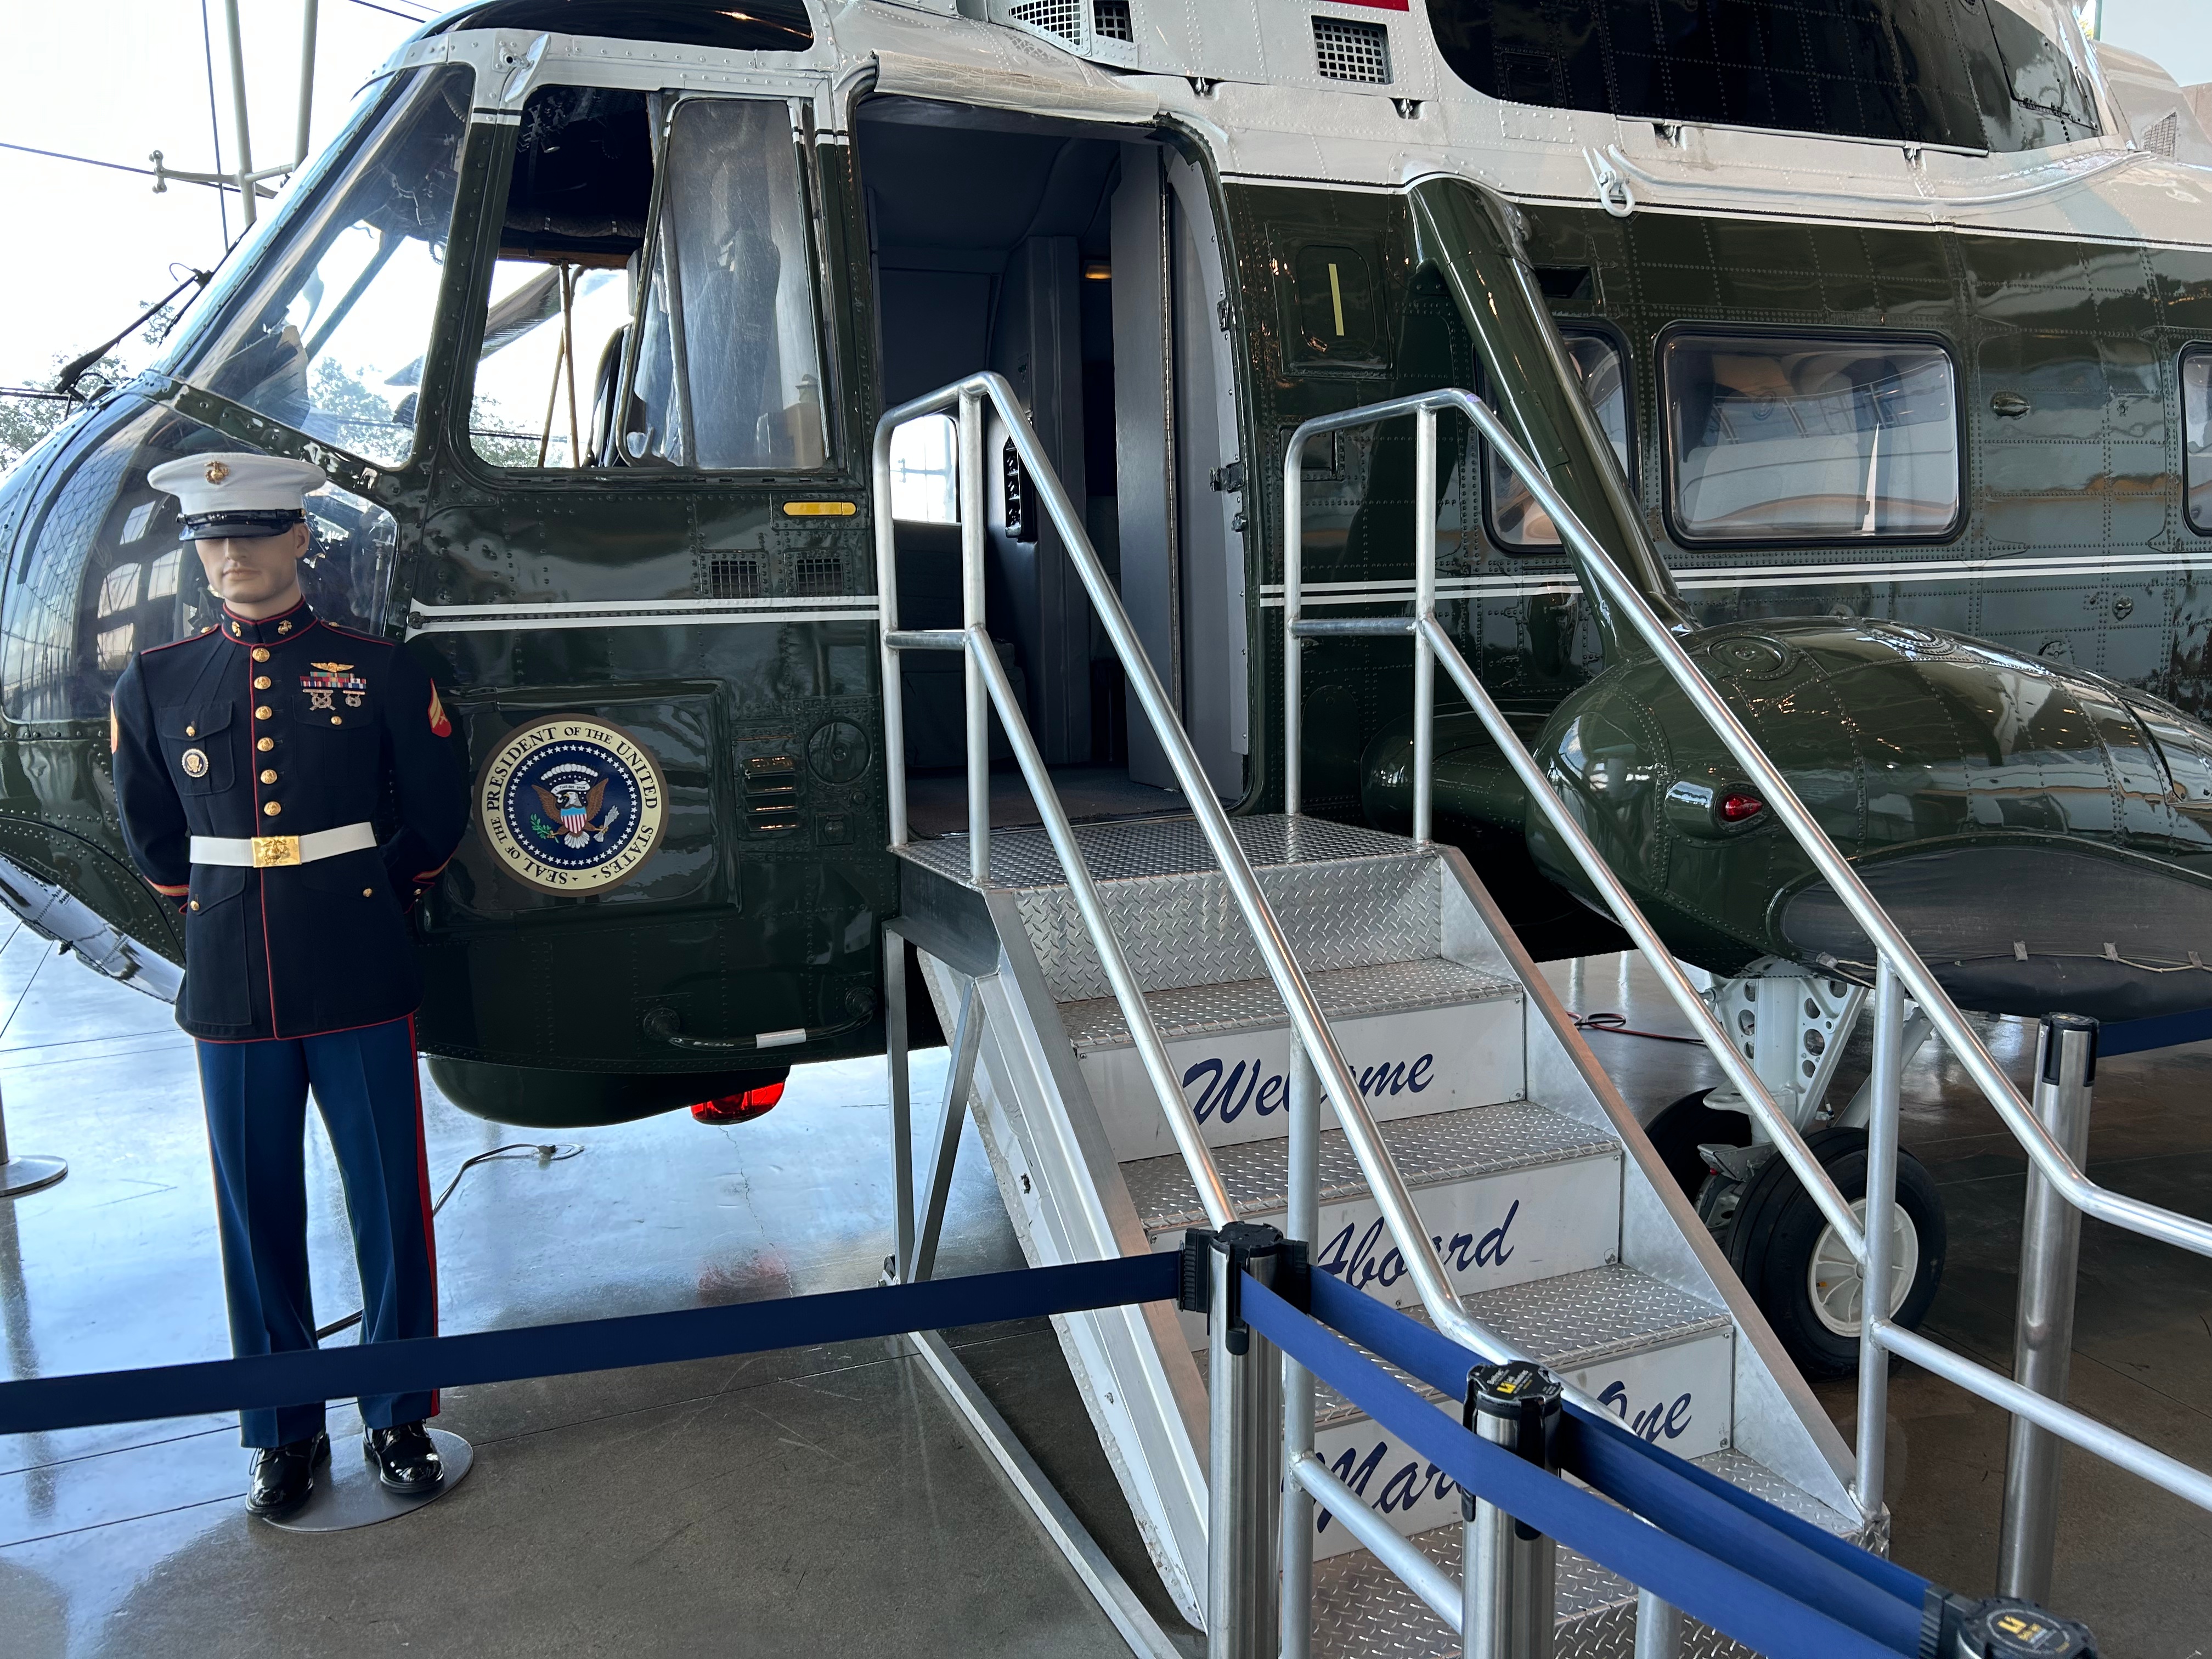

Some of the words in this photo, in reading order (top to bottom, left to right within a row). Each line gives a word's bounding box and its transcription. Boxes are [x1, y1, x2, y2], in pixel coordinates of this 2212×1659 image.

[564, 727, 581, 736] OF
[585, 727, 613, 744] THE
[487, 727, 556, 811] PRESIDENT
[616, 741, 657, 809] UNITED
[490, 817, 508, 844] THE
[505, 845, 520, 859] OF
[600, 825, 654, 879] STATES
[523, 857, 568, 884] SEAL
[1182, 1053, 1434, 1125] Weme
[1317, 1199, 1519, 1290] Abord
[1281, 1441, 1462, 1533] Mar
